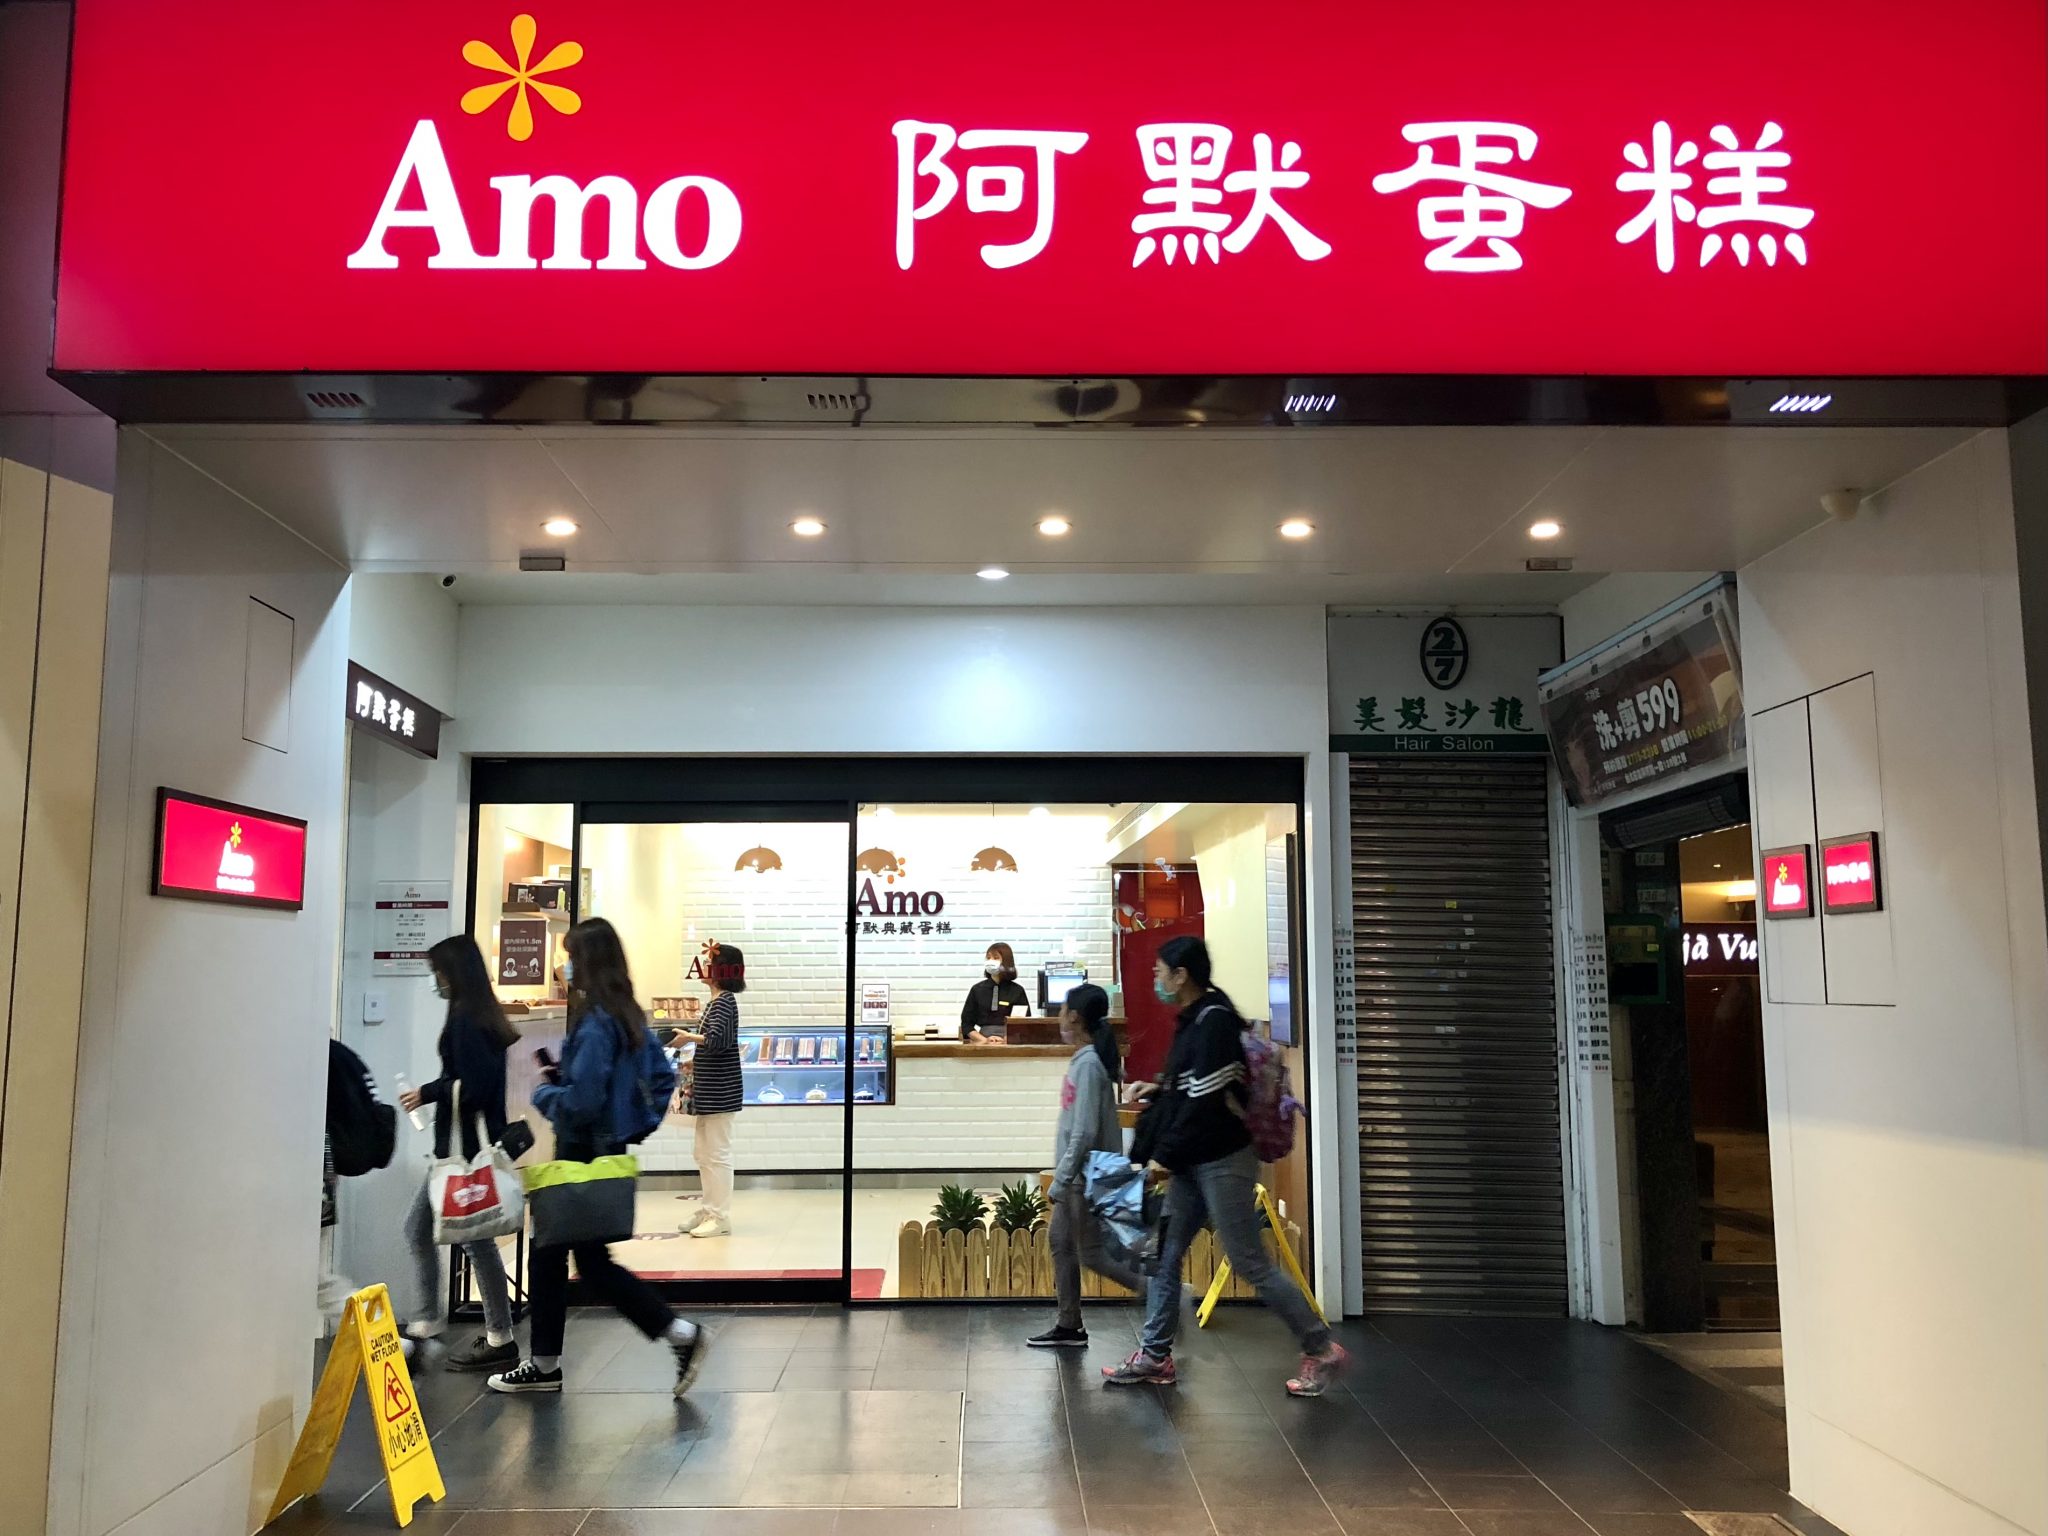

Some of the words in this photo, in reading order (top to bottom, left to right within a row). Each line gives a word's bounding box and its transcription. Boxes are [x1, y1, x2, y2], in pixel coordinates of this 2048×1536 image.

[346, 118, 743, 271] Amo
[891, 117, 1815, 273] 阿默蛋糕
[1353, 695, 1534, 733] 美髮沙龍
[1394, 735, 1431, 751] Hair
[1441, 735, 1495, 751] Salon
[856, 877, 944, 916] Amo
[1717, 932, 1758, 961] Vu
[370, 1350, 382, 1363] WET
[382, 1342, 400, 1358] FLOOR
[371, 1332, 394, 1350] CAUTION
